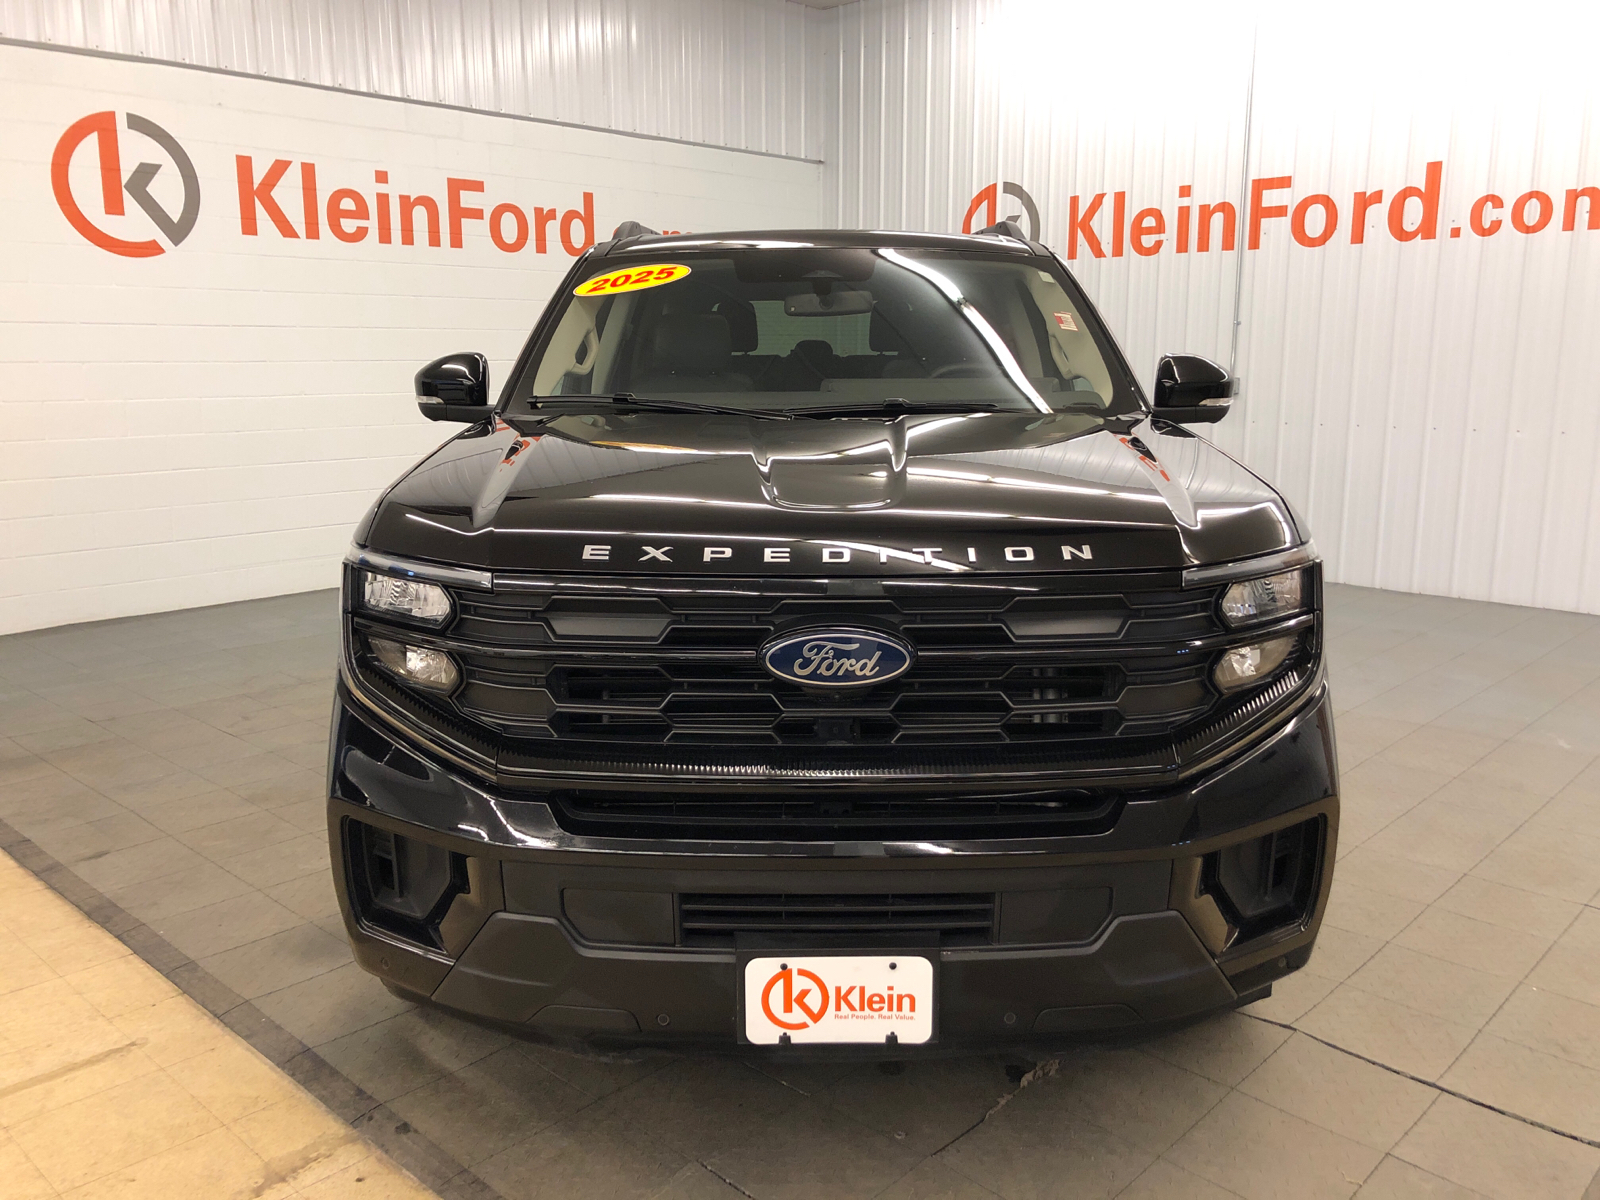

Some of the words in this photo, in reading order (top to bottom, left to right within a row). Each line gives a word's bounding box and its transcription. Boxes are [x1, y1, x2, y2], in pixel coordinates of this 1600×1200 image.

[234, 154, 694, 257] KleinFord
[585, 266, 678, 294] 2025
[582, 543, 1094, 564] EXPEDITION
[793, 641, 882, 678] Ford
[834, 985, 916, 1013] Klein
[850, 1013, 877, 1021] People.
[894, 1013, 916, 1021] Value.
